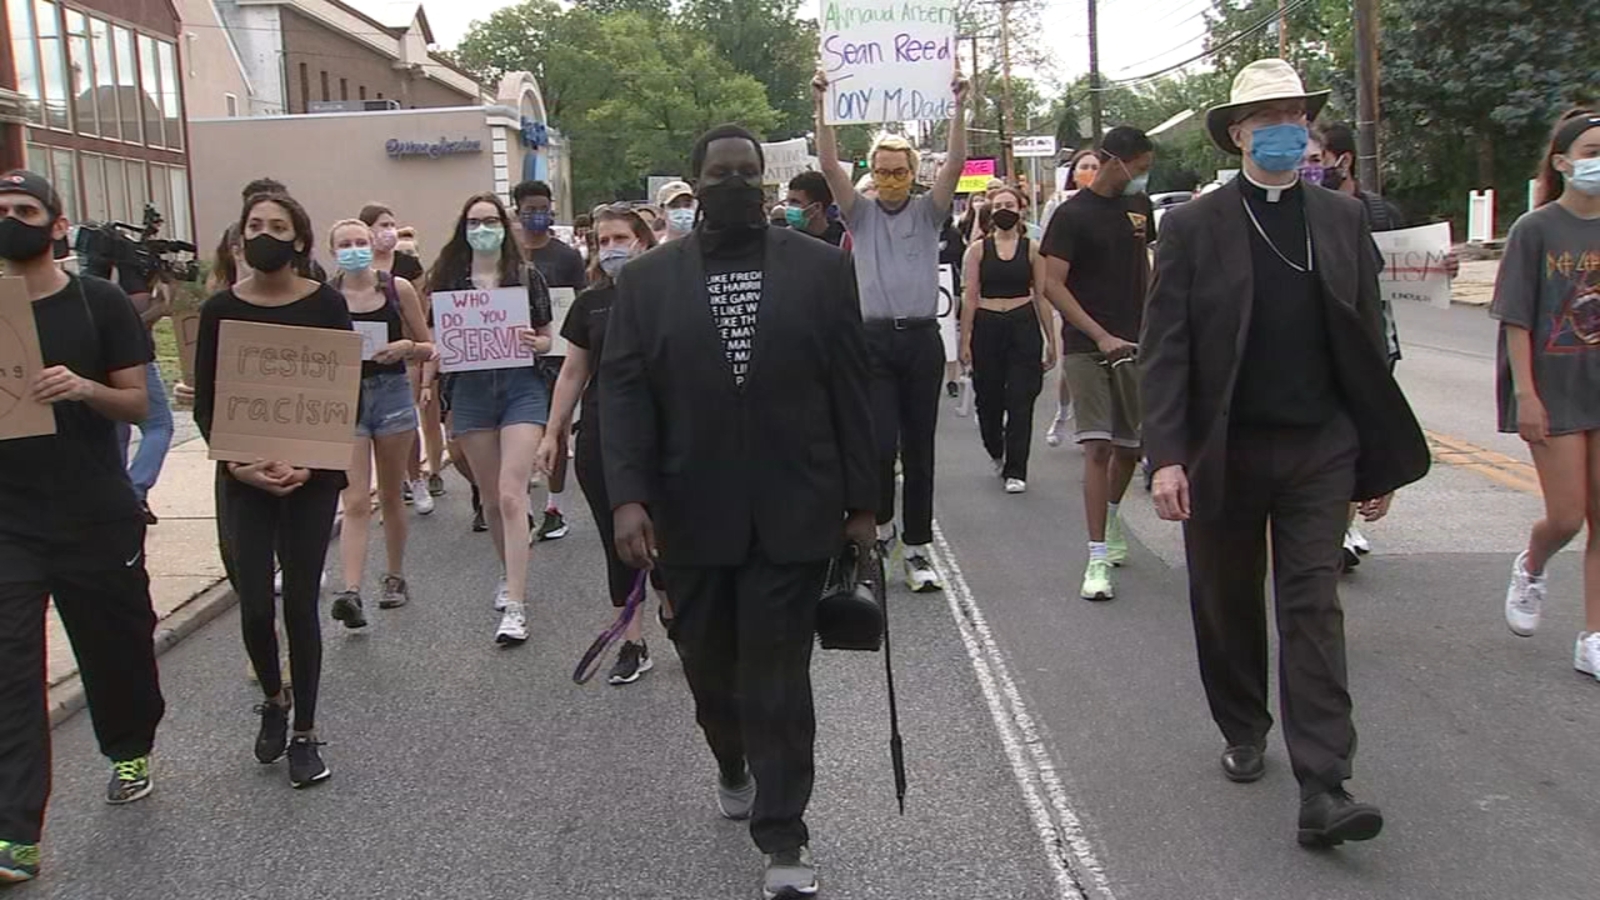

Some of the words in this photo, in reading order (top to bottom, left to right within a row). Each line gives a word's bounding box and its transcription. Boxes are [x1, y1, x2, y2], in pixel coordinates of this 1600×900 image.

[825, 35, 883, 72] Sean
[894, 33, 951, 62] Reed
[452, 292, 490, 307] WHO
[720, 304, 744, 316] LIKE
[441, 313, 463, 329] DO
[480, 309, 507, 324] YOU
[442, 325, 530, 366] SERVE
[237, 345, 340, 382] resist
[227, 393, 350, 425] racism
